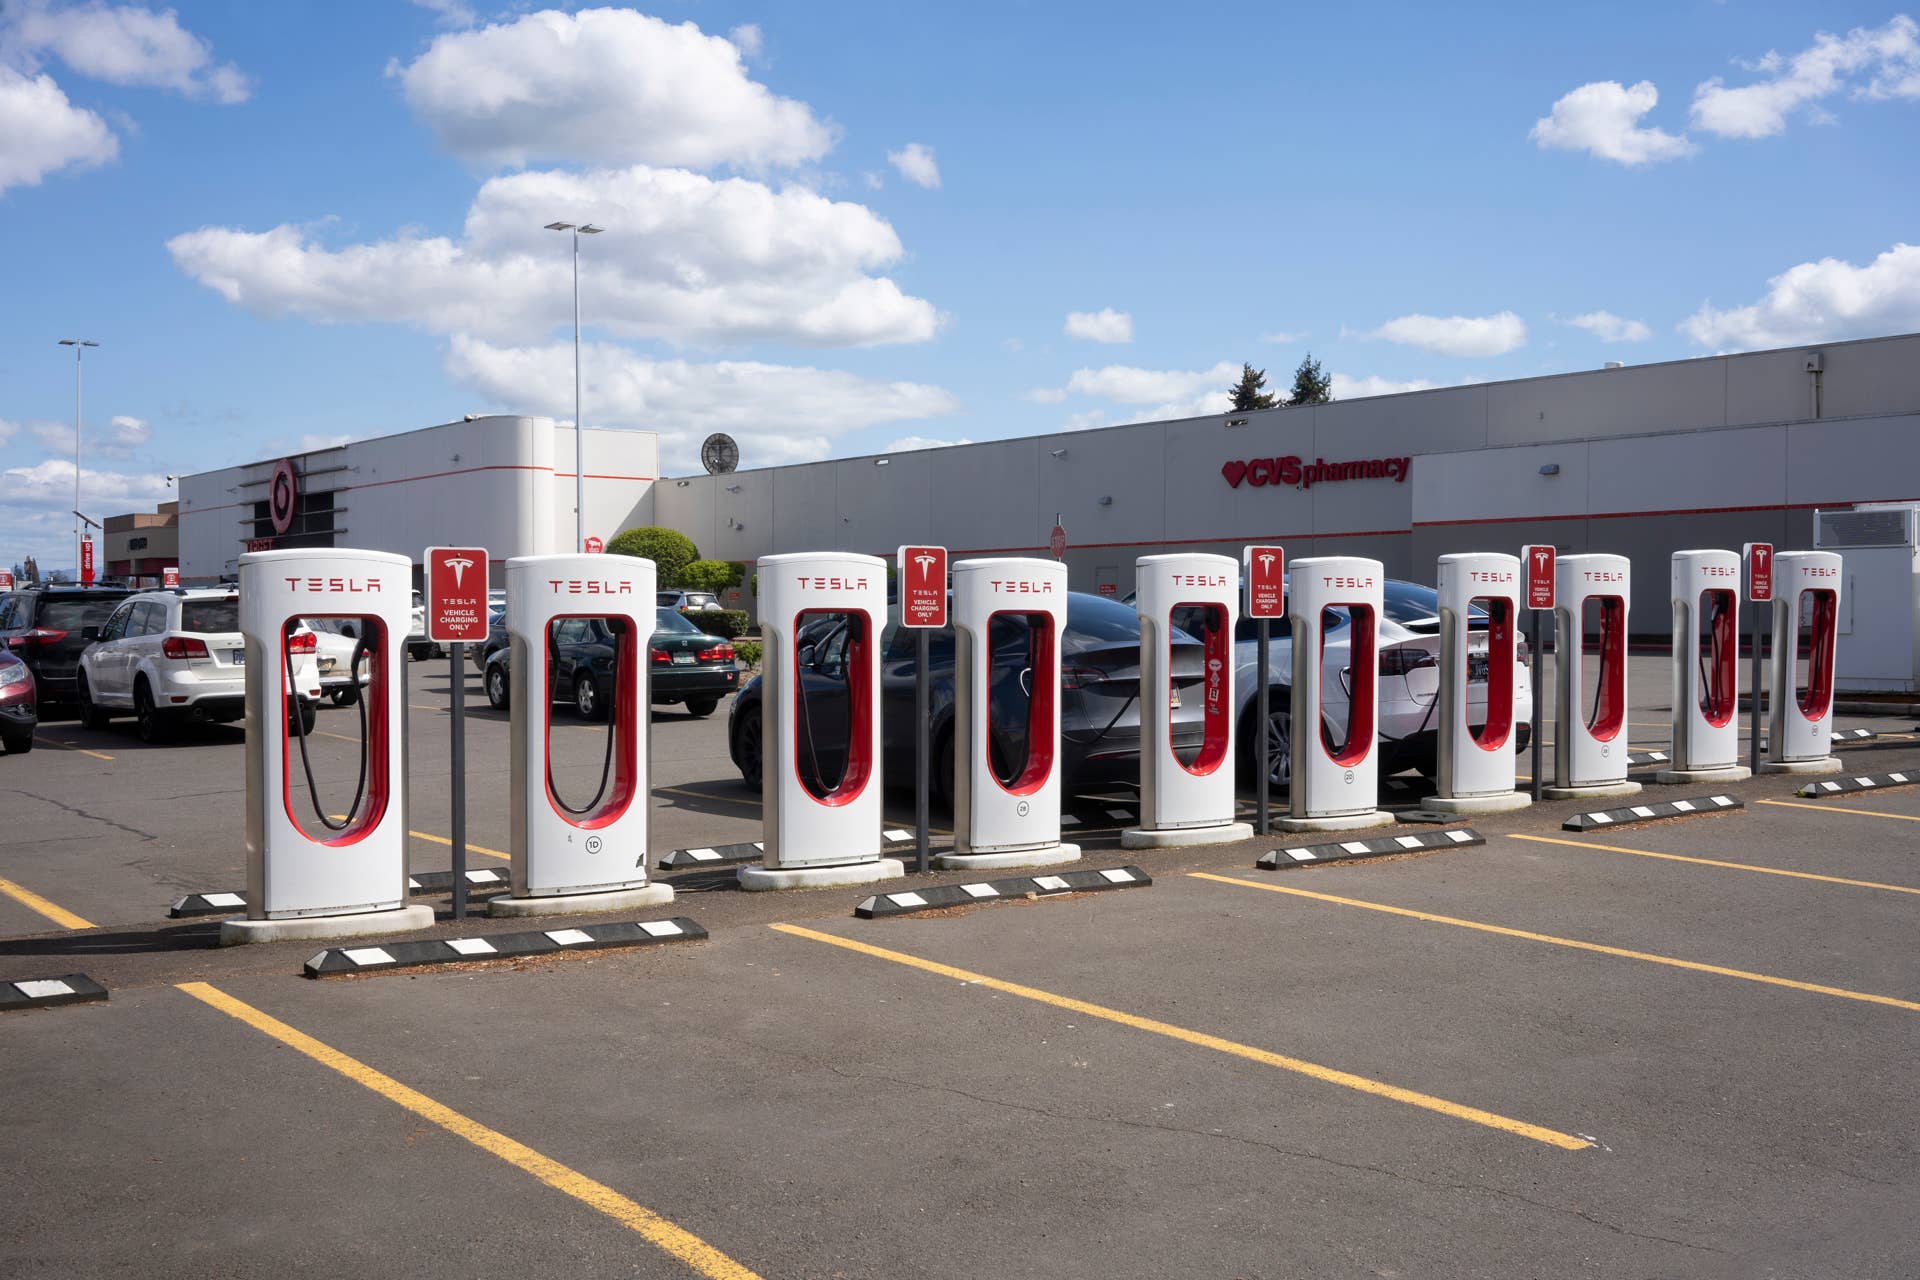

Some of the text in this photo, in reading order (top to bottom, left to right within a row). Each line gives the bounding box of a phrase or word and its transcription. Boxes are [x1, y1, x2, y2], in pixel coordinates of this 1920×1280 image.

[1247, 455, 1411, 489] CVS pharmacy
[1701, 566, 1736, 576] TESLA
[1802, 567, 1837, 577] TESLA
[1171, 575, 1226, 587] TESLA
[1323, 577, 1373, 588] TESLA
[1470, 572, 1513, 583] TESLA
[1583, 572, 1623, 582] TESLA
[284, 577, 381, 592] TESLA
[548, 580, 632, 594] TESLA
[797, 577, 868, 590] TESLA
[990, 581, 1052, 593] TESLA
[589, 841, 599, 849] 1D
